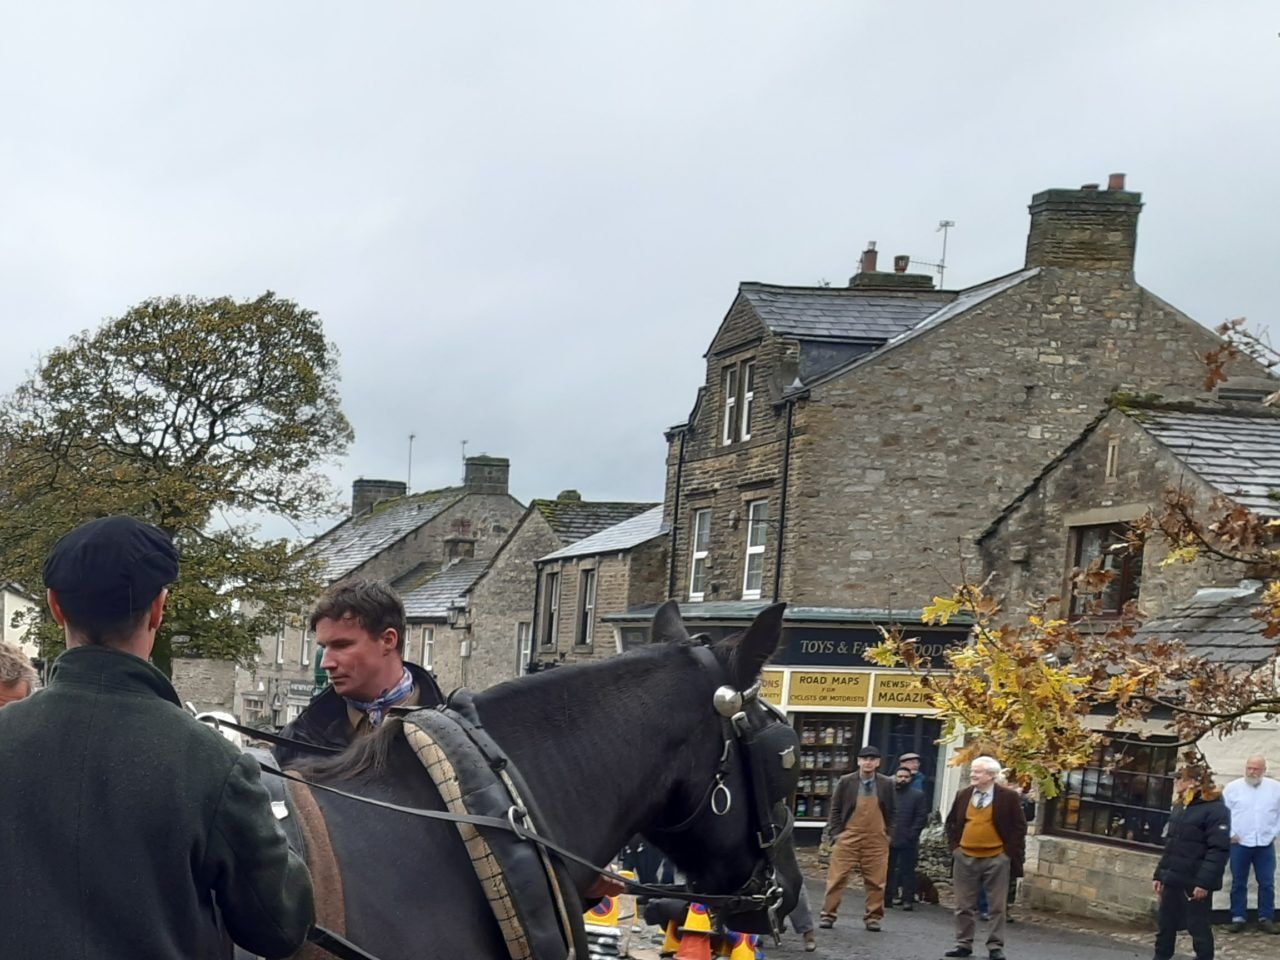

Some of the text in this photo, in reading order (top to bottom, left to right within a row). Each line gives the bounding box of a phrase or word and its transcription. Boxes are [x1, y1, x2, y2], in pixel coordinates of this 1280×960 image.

[800, 640, 834, 653] TOYS
[837, 641, 849, 654] &
[799, 676, 860, 685] ROAD MAPS
